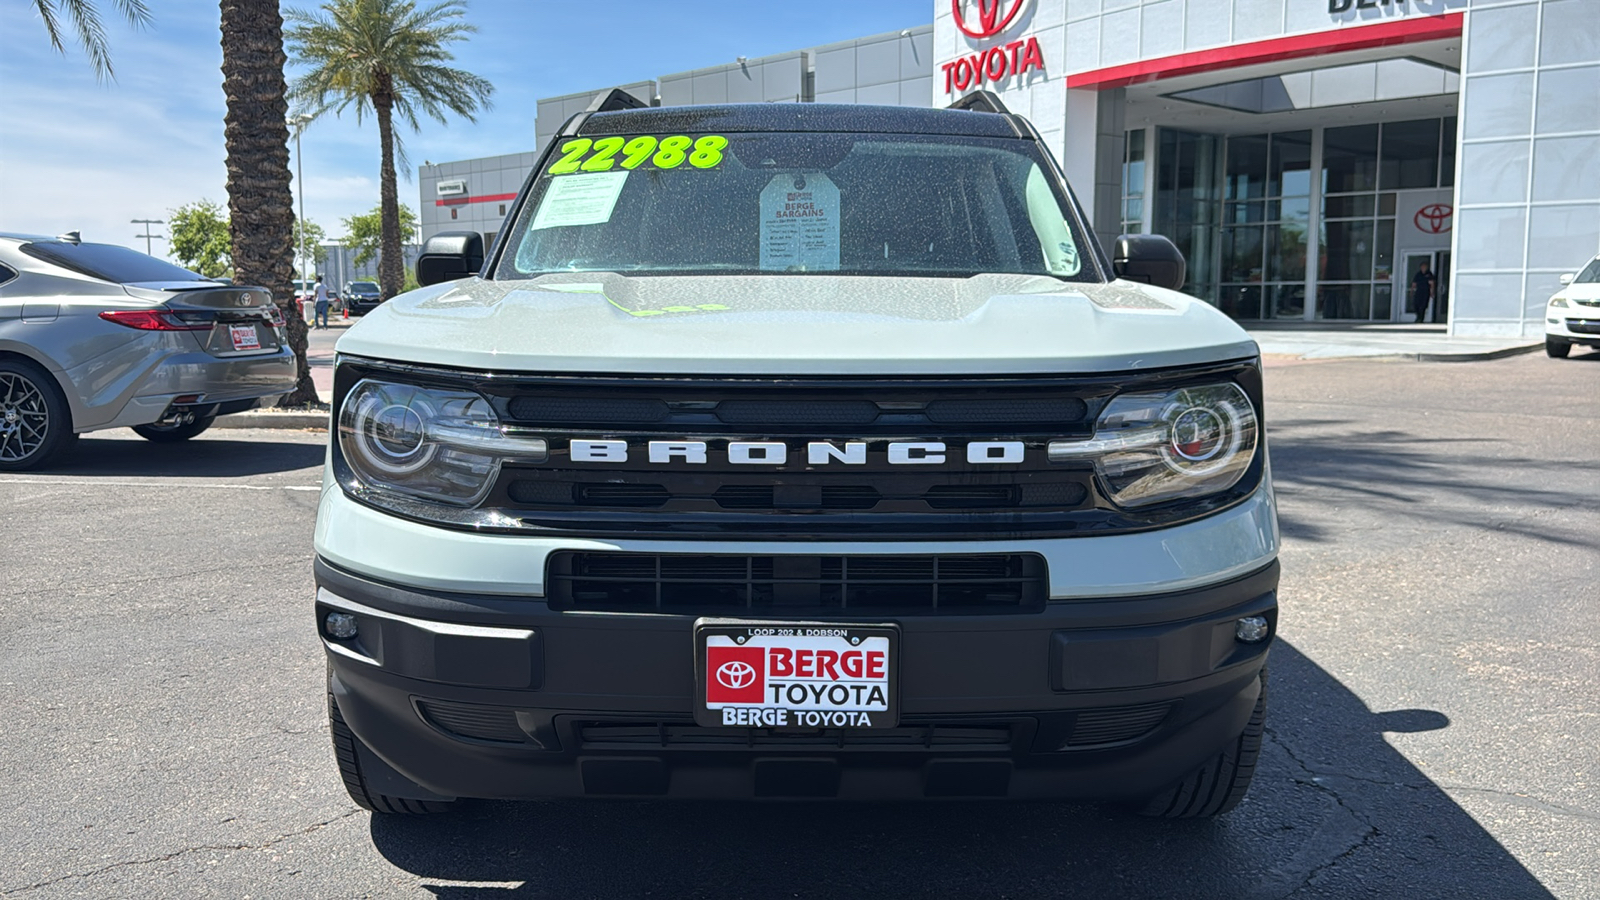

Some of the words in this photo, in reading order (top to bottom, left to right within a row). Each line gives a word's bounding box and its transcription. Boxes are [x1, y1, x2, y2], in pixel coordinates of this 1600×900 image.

[942, 37, 1044, 94] TOYOTA
[547, 135, 729, 175] 22988
[776, 209, 824, 218] BARGAINS
[785, 202, 815, 210] BERGE
[569, 439, 1025, 464] BRONCO
[748, 628, 775, 636] LOOP
[806, 629, 848, 637] DOBSON
[769, 647, 886, 682] BERGE
[768, 683, 887, 706] TOYOTA
[722, 706, 788, 727] BERGE
[794, 711, 872, 727] TOYOTA
